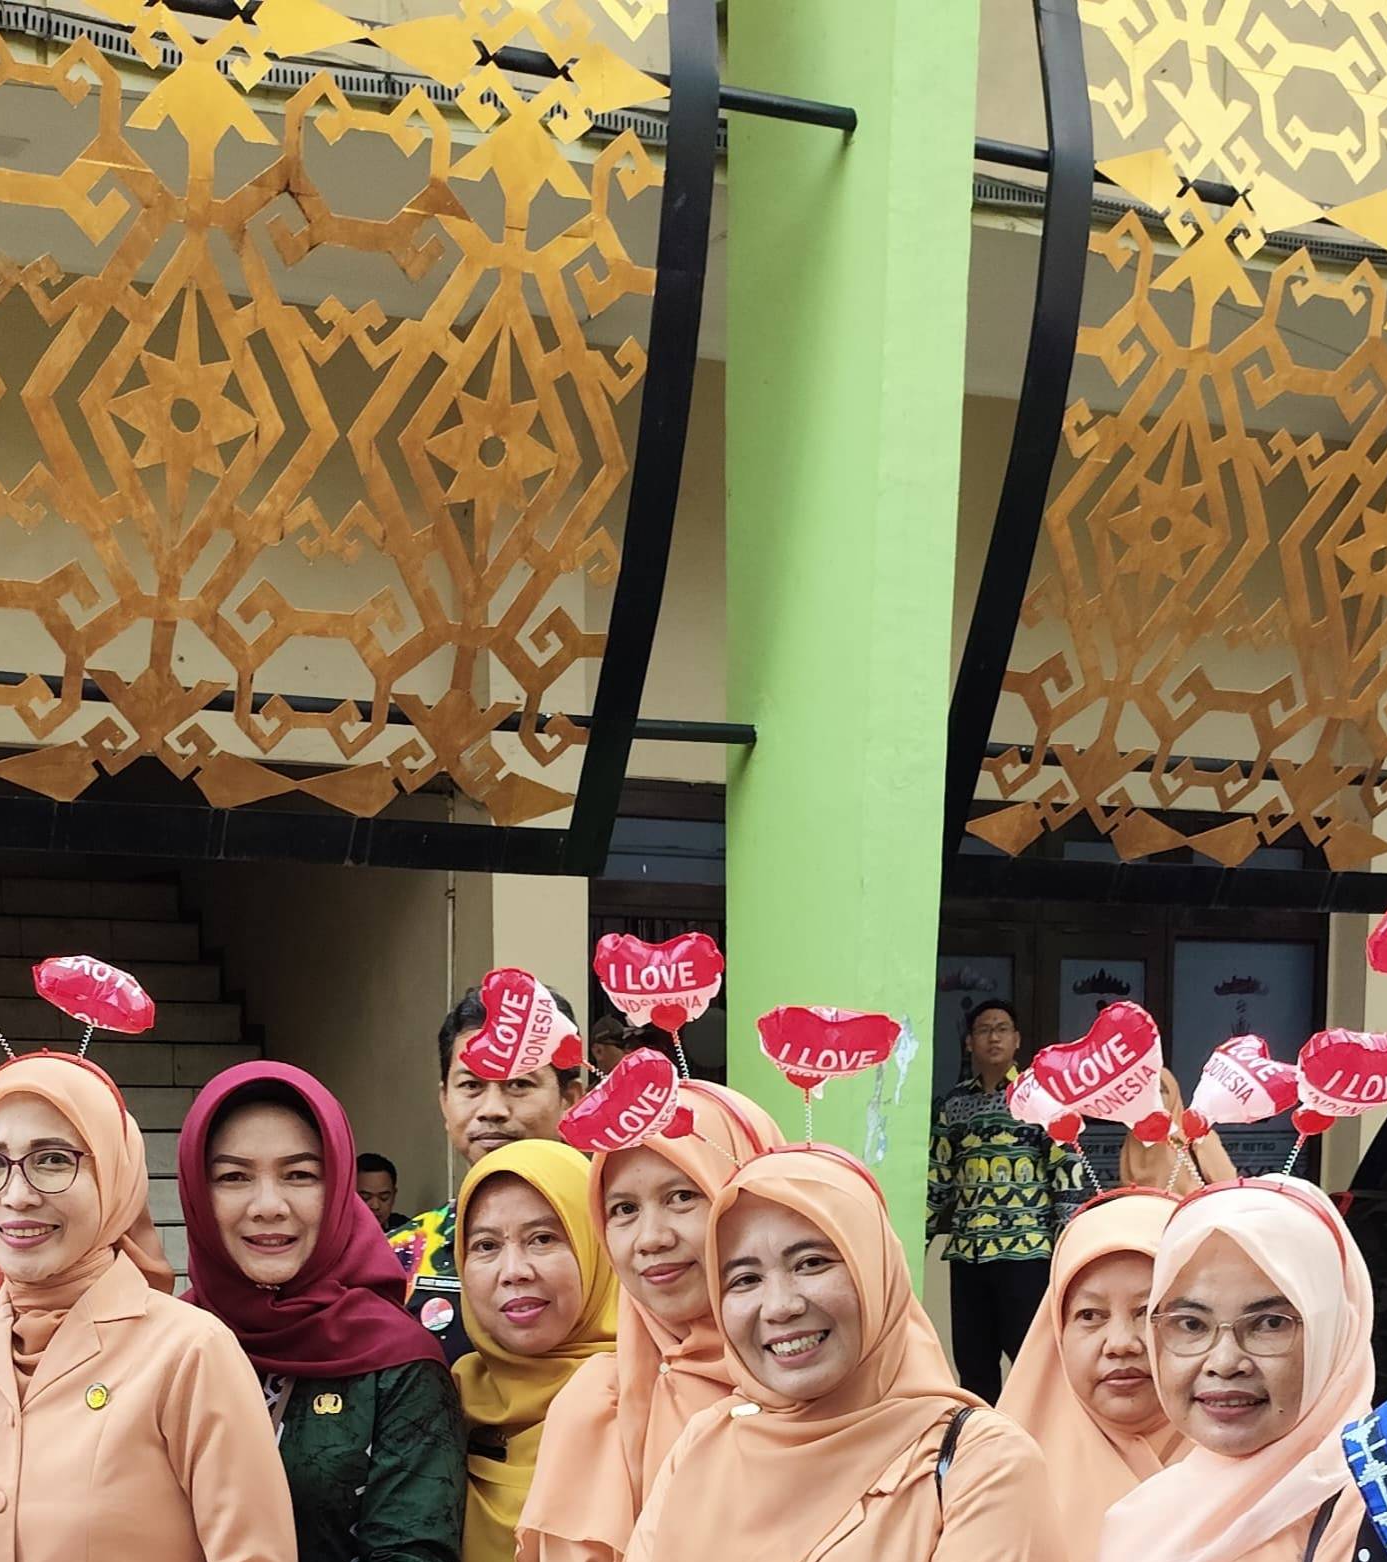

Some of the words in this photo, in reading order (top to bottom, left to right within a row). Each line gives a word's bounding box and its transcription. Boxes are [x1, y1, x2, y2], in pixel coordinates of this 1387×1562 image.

[610, 963, 618, 989] I
[625, 961, 698, 991] LOVE
[488, 988, 530, 1060] LOVE
[481, 1058, 506, 1073] I
[777, 1042, 792, 1061] I
[797, 1047, 878, 1070] LOVE
[1047, 1075, 1066, 1101] I
[1062, 1032, 1137, 1095] LOVE
[1322, 1069, 1344, 1091] I
[590, 1138, 608, 1149] I
[605, 1082, 669, 1143] LOVE
